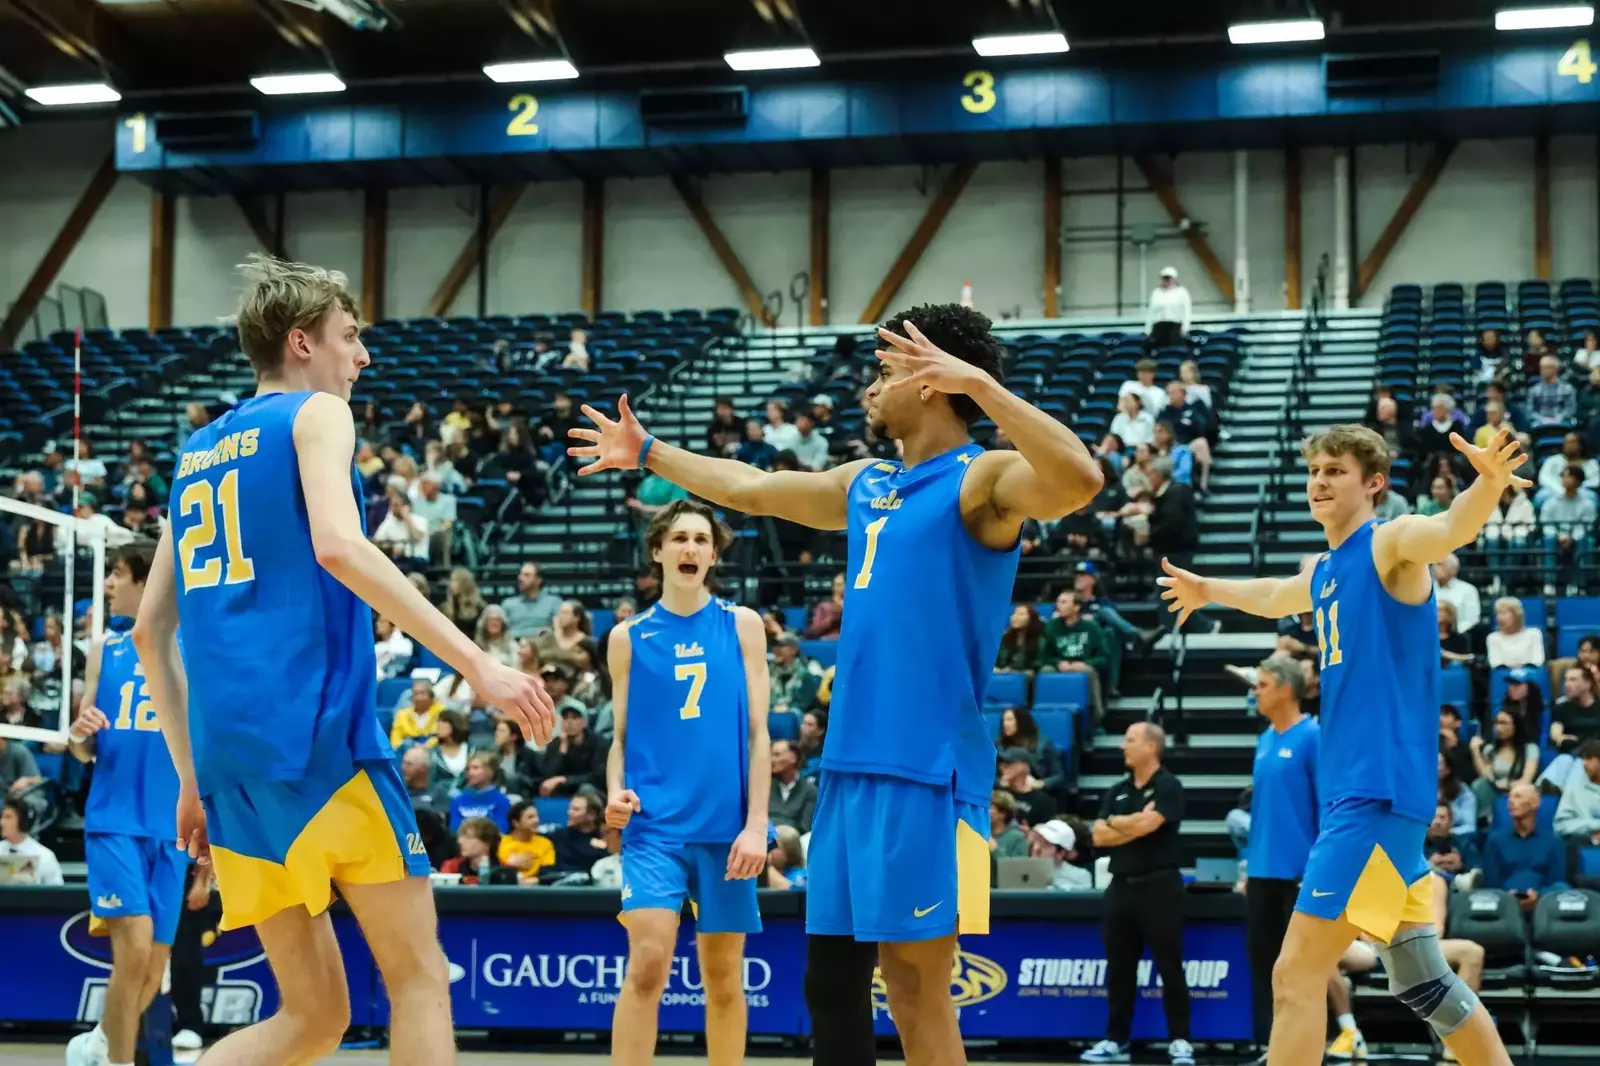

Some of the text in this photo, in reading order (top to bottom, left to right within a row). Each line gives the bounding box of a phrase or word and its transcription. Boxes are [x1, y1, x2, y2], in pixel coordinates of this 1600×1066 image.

[1557, 39, 1598, 84] 4
[960, 70, 997, 114] 3
[125, 112, 146, 154] 1
[506, 94, 539, 136] 2
[178, 469, 256, 596] 21
[853, 516, 890, 589] 1
[1315, 600, 1343, 671] 11
[114, 680, 161, 732] 12
[674, 662, 708, 720] 7
[482, 952, 772, 992] GAUCH FUD
[1017, 957, 1109, 987] STUDENT
[578, 992, 588, 1004] A
